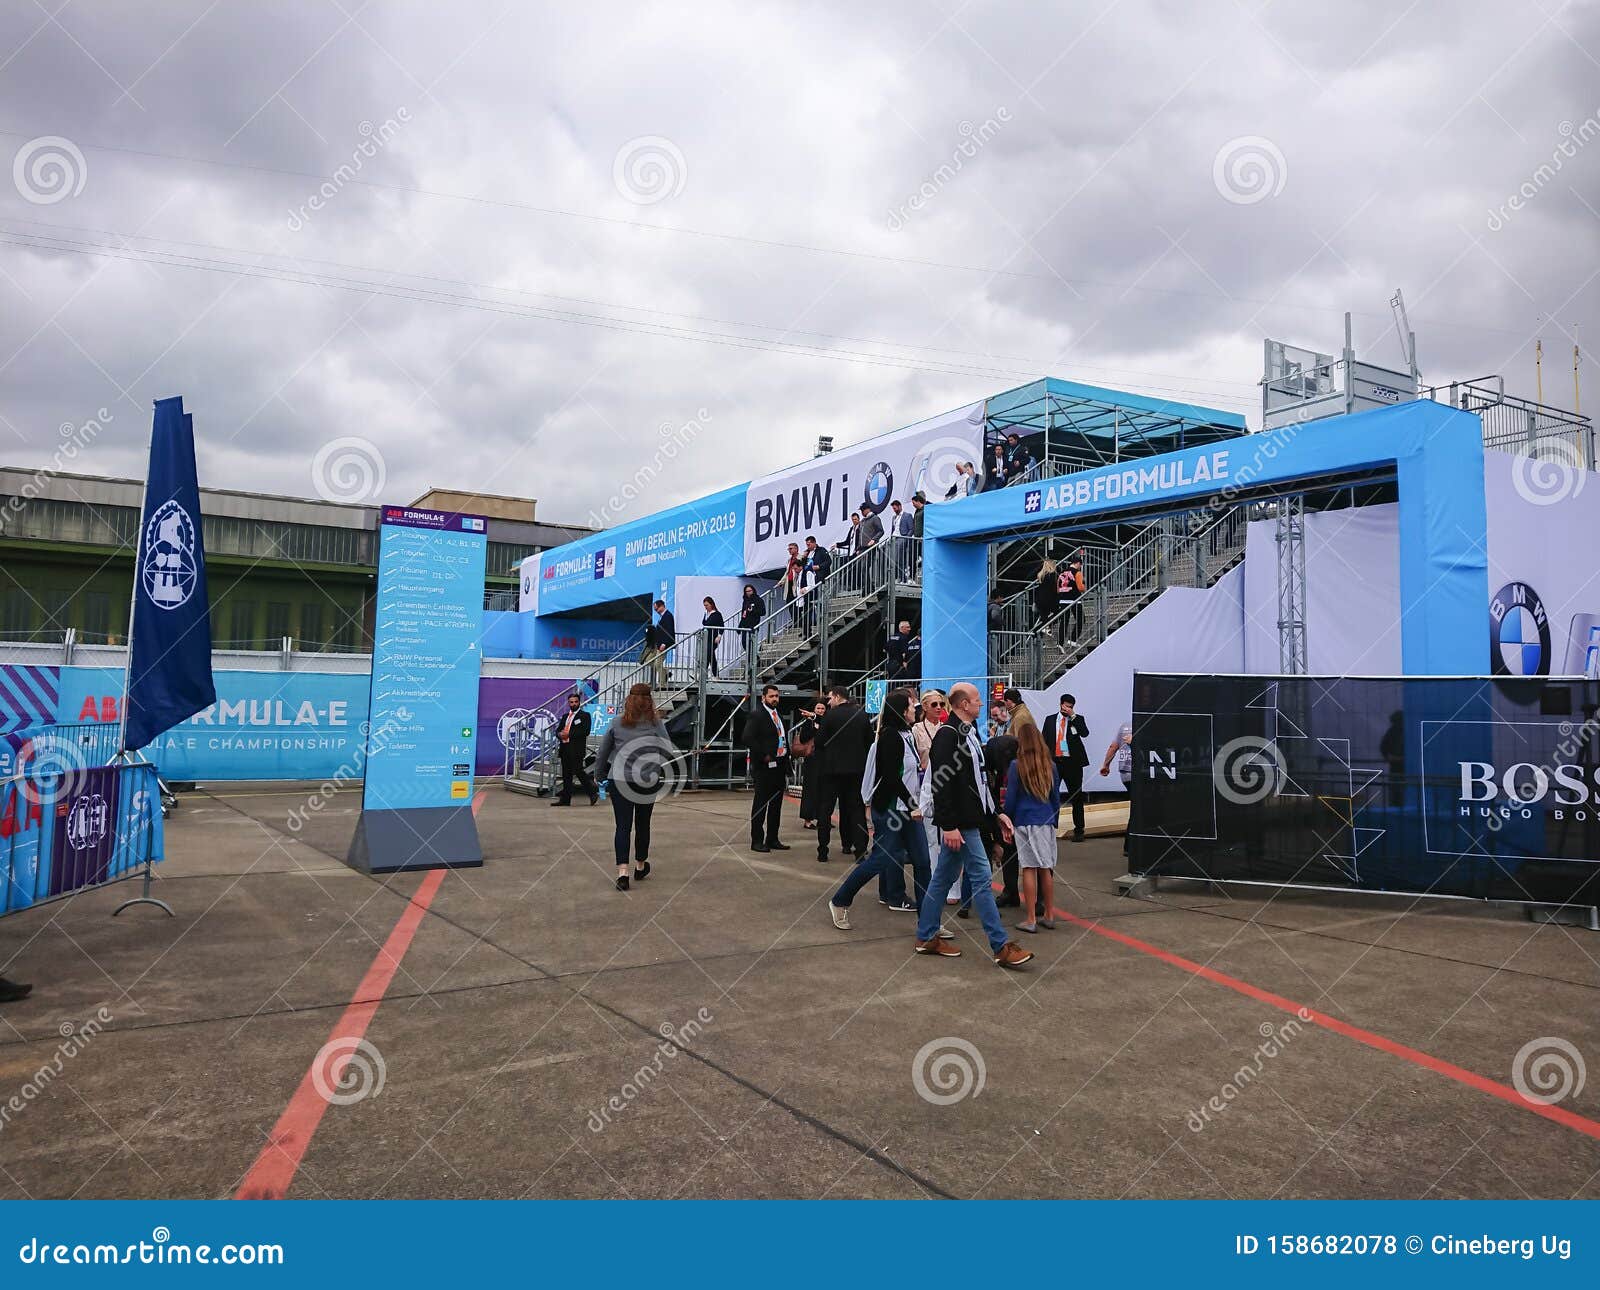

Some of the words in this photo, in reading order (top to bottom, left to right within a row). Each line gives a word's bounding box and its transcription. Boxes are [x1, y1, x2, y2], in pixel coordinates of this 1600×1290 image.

[755, 478, 833, 543] BMW
[842, 473, 848, 521] i
[625, 538, 644, 557] BMW
[648, 528, 677, 551] BERLIN
[678, 519, 708, 543] E-PRIX
[709, 511, 736, 534] 2019
[1490, 584, 1546, 625] BMW
[551, 636, 576, 648] ABB
[78, 695, 129, 723] AB
[208, 737, 347, 751] CHAMPIONSHIP
[1457, 761, 1600, 805] BOS
[1460, 806, 1532, 819] HUGO
